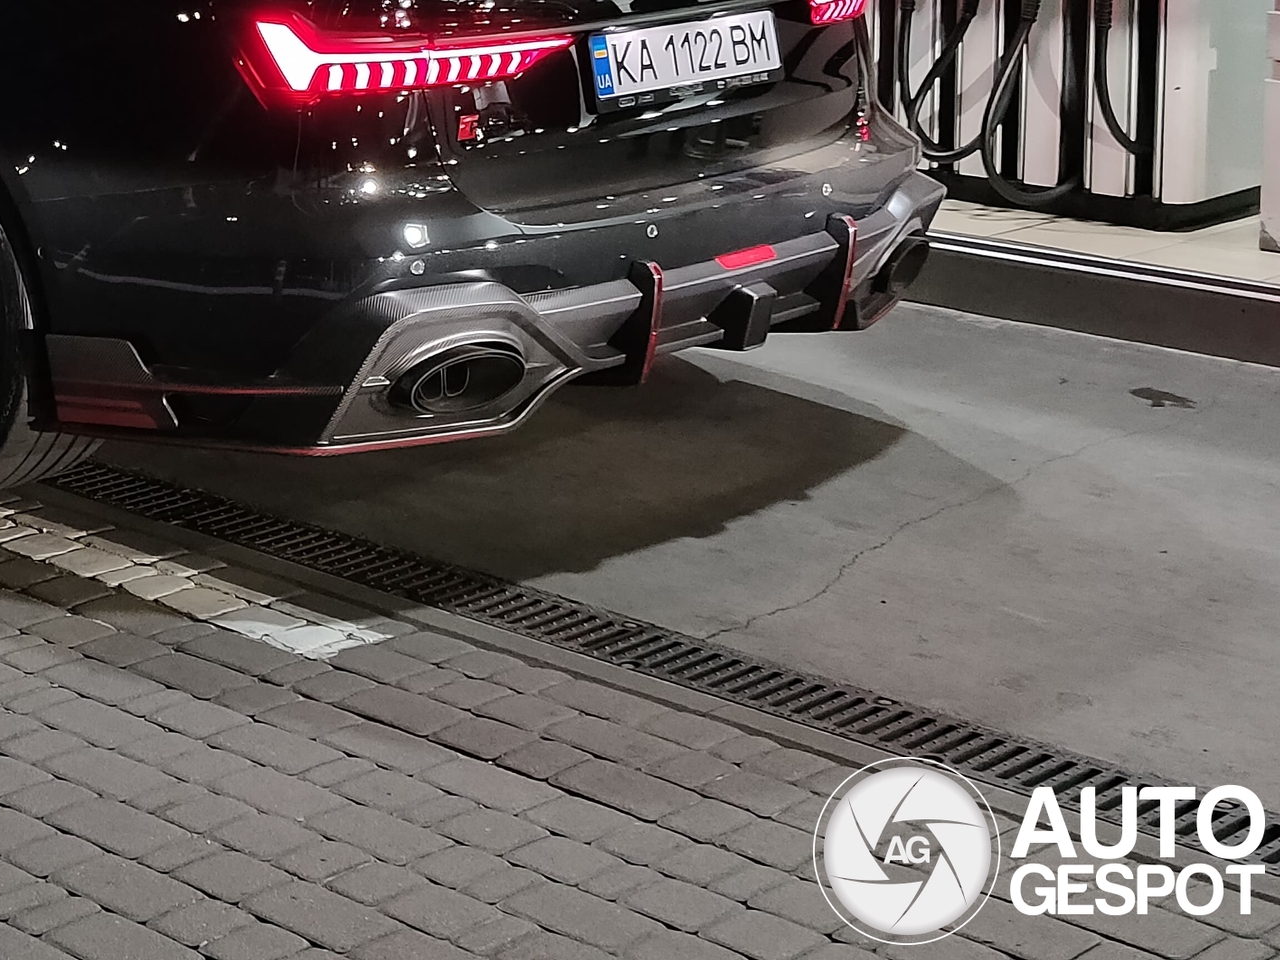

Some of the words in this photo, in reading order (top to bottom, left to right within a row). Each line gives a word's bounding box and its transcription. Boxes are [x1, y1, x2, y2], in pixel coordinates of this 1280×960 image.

[611, 39, 658, 86] KA
[664, 29, 727, 77] 1122
[729, 21, 771, 66] BM
[597, 73, 613, 89] UA
